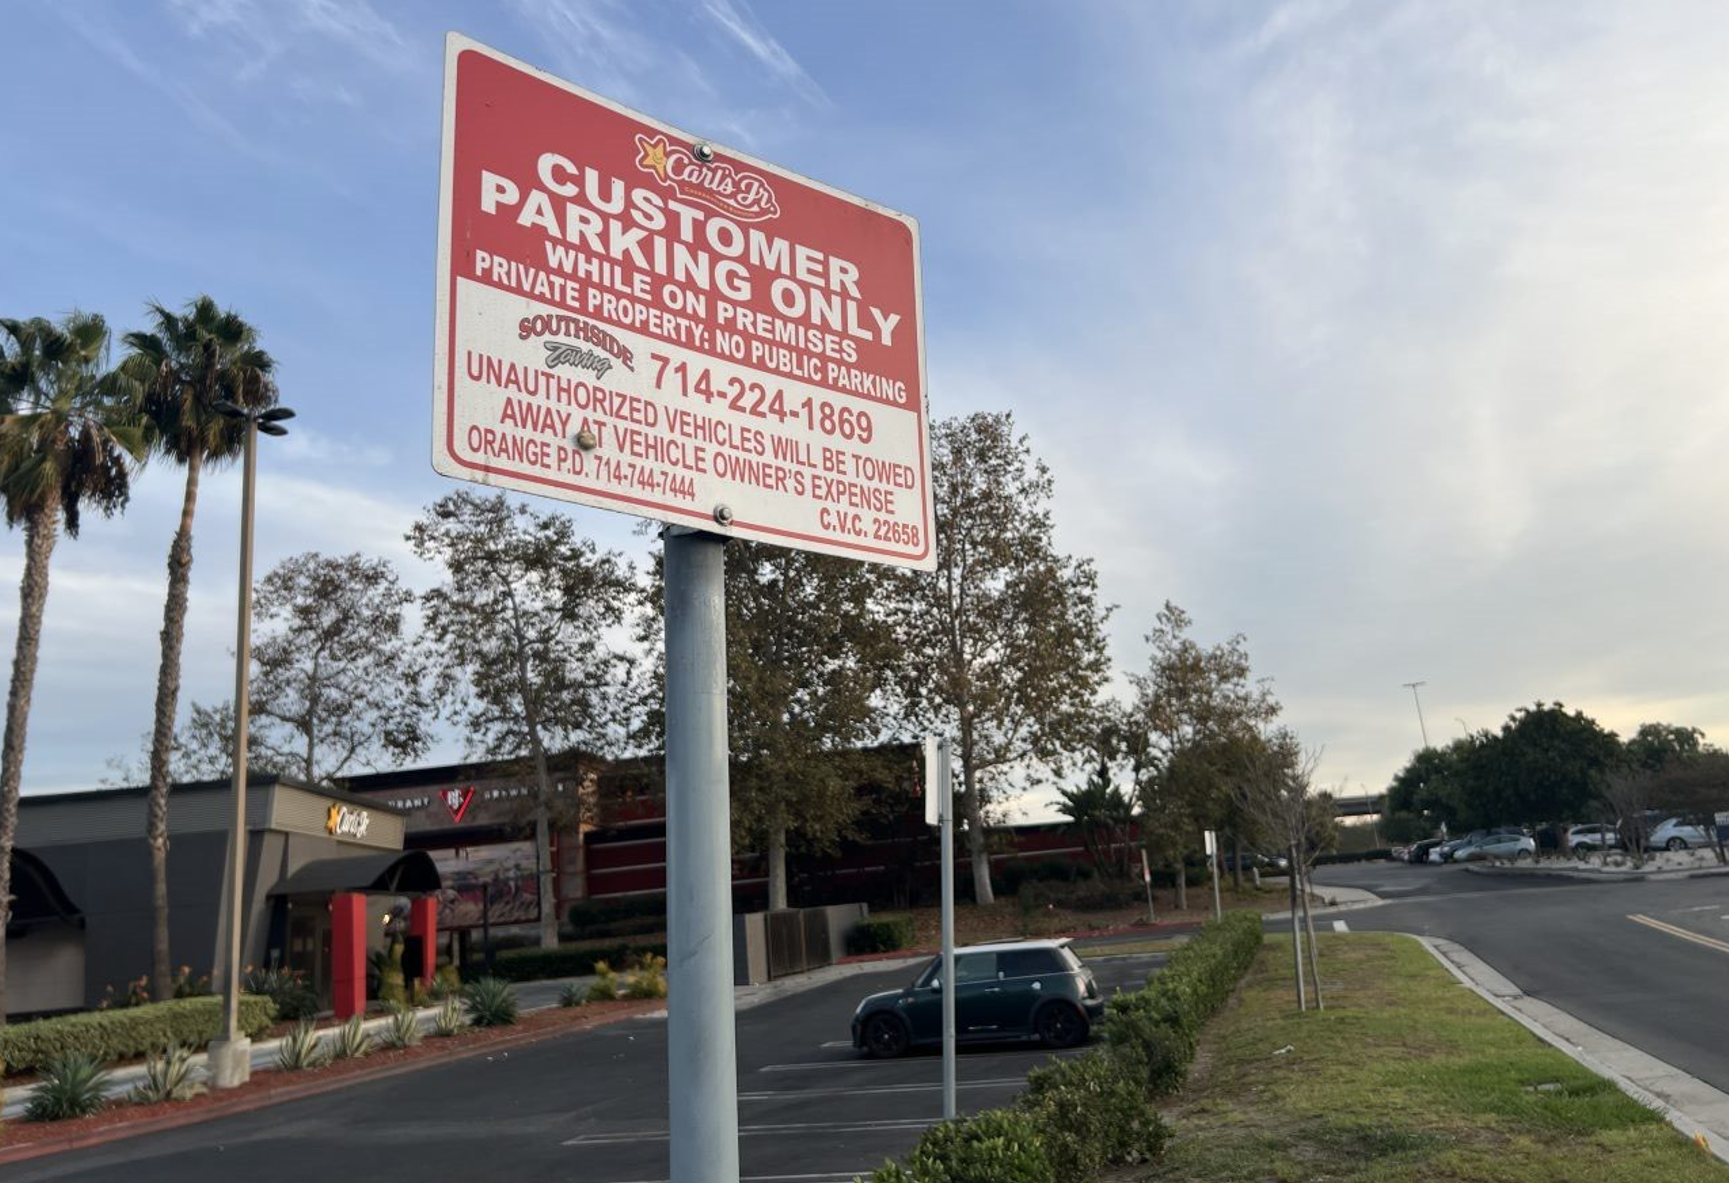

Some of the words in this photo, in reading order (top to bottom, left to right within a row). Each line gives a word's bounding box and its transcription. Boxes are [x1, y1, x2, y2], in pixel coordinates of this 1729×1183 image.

[537, 152, 861, 299] CUSTOMER
[666, 153, 736, 194] Carl's
[481, 170, 752, 301] PARKING
[771, 278, 901, 347] ONLY
[545, 240, 652, 301] WHILE
[662, 284, 706, 319] ON
[717, 301, 858, 363] PREMISES
[475, 249, 580, 308] PRIVATE
[588, 287, 709, 349] PROPERTY:
[715, 329, 746, 359] NO
[752, 340, 822, 381] PUBLIC
[827, 362, 907, 403] PARKING
[518, 314, 635, 372] SOUTHSIDE
[544, 341, 613, 380] Towing
[467, 350, 658, 428] UNAUTHORIZED
[664, 406, 765, 456] VEHICLES
[771, 434, 817, 468] WILL
[822, 447, 847, 475] BE
[852, 453, 915, 490] TOWED
[650, 353, 873, 444] 714-224-1869
[468, 425, 551, 469] ORANGE
[557, 445, 589, 478] P.D.
[594, 455, 695, 501] 714-744-7444
[500, 397, 571, 438] AWAY
[613, 425, 707, 474] VEHICLE
[713, 452, 805, 496] OWNER'S
[812, 475, 895, 514] EXPENSE
[820, 507, 868, 538] C.V.C.
[873, 518, 920, 547] 22658
